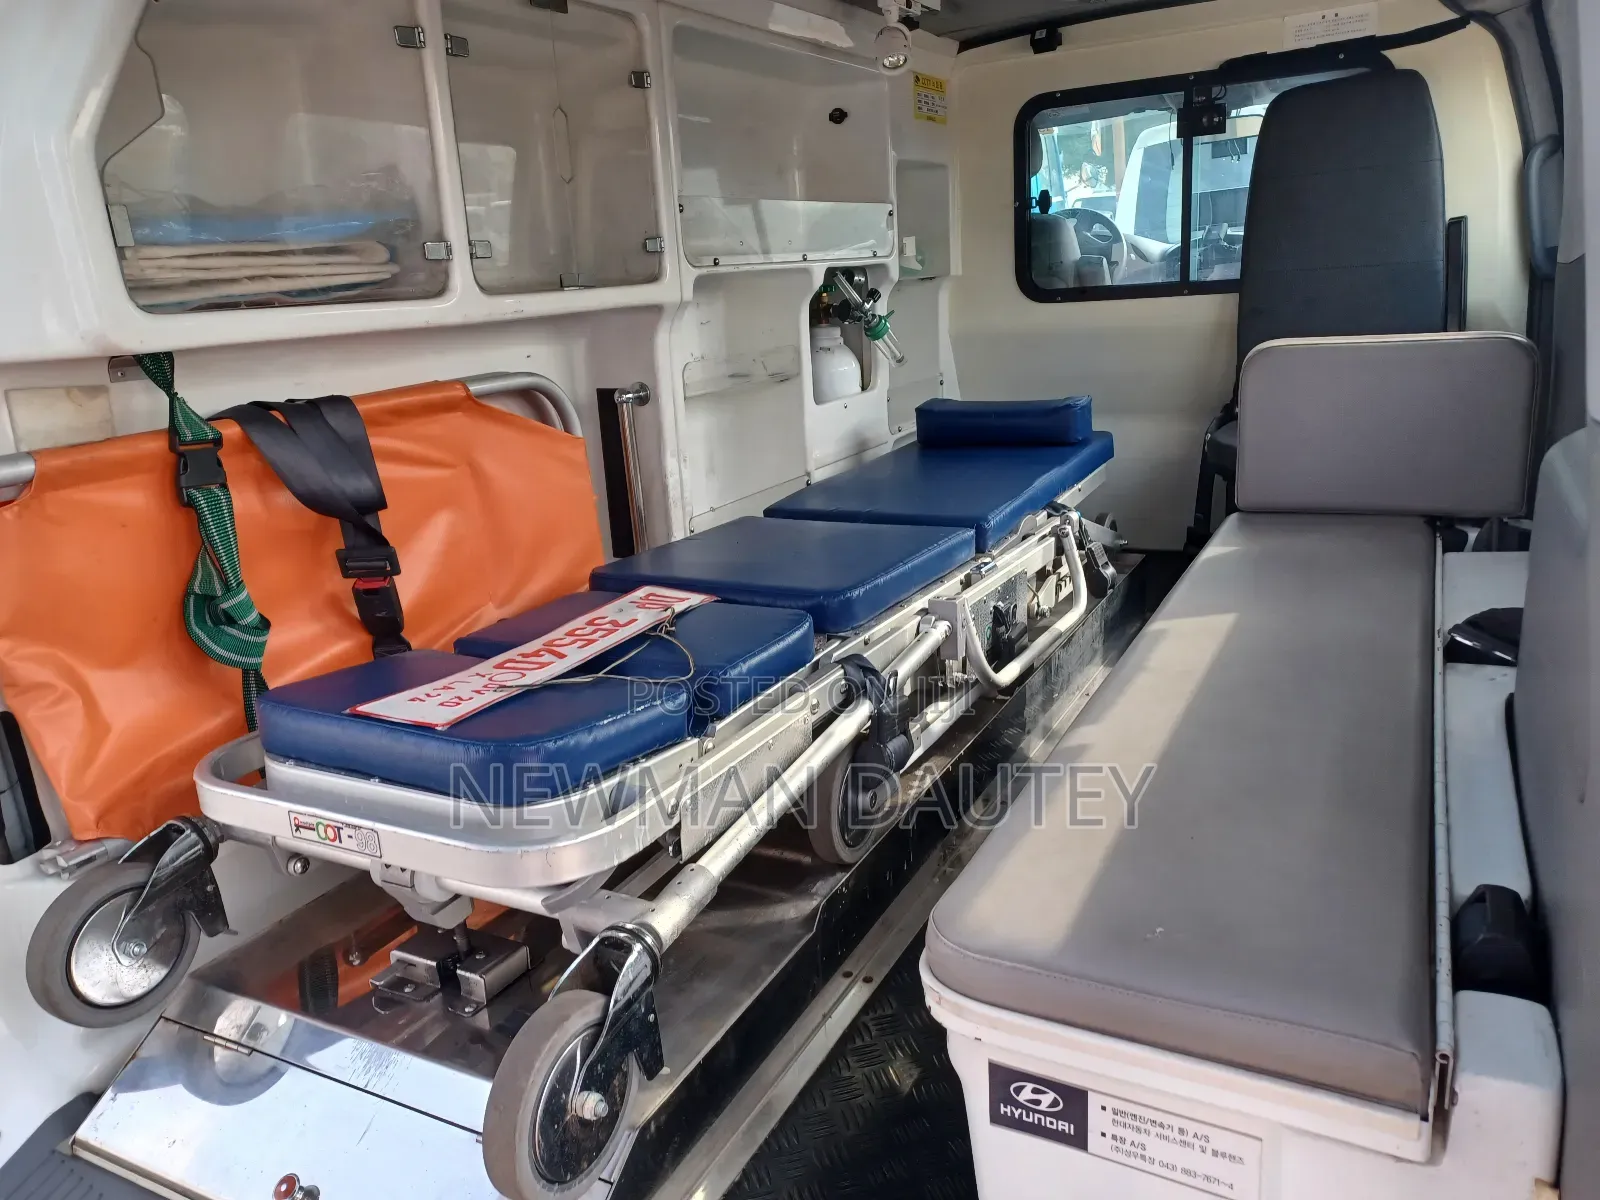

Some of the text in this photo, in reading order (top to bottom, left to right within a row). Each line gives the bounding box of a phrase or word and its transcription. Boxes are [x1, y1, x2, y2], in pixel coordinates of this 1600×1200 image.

[628, 592, 691, 610] DP
[1000, 1102, 1075, 1136] HYUNDAI
[1111, 1133, 1147, 1152] 특장 A/S
[1192, 1131, 1210, 1144] A/S
[1158, 1160, 1178, 1173] 043)
